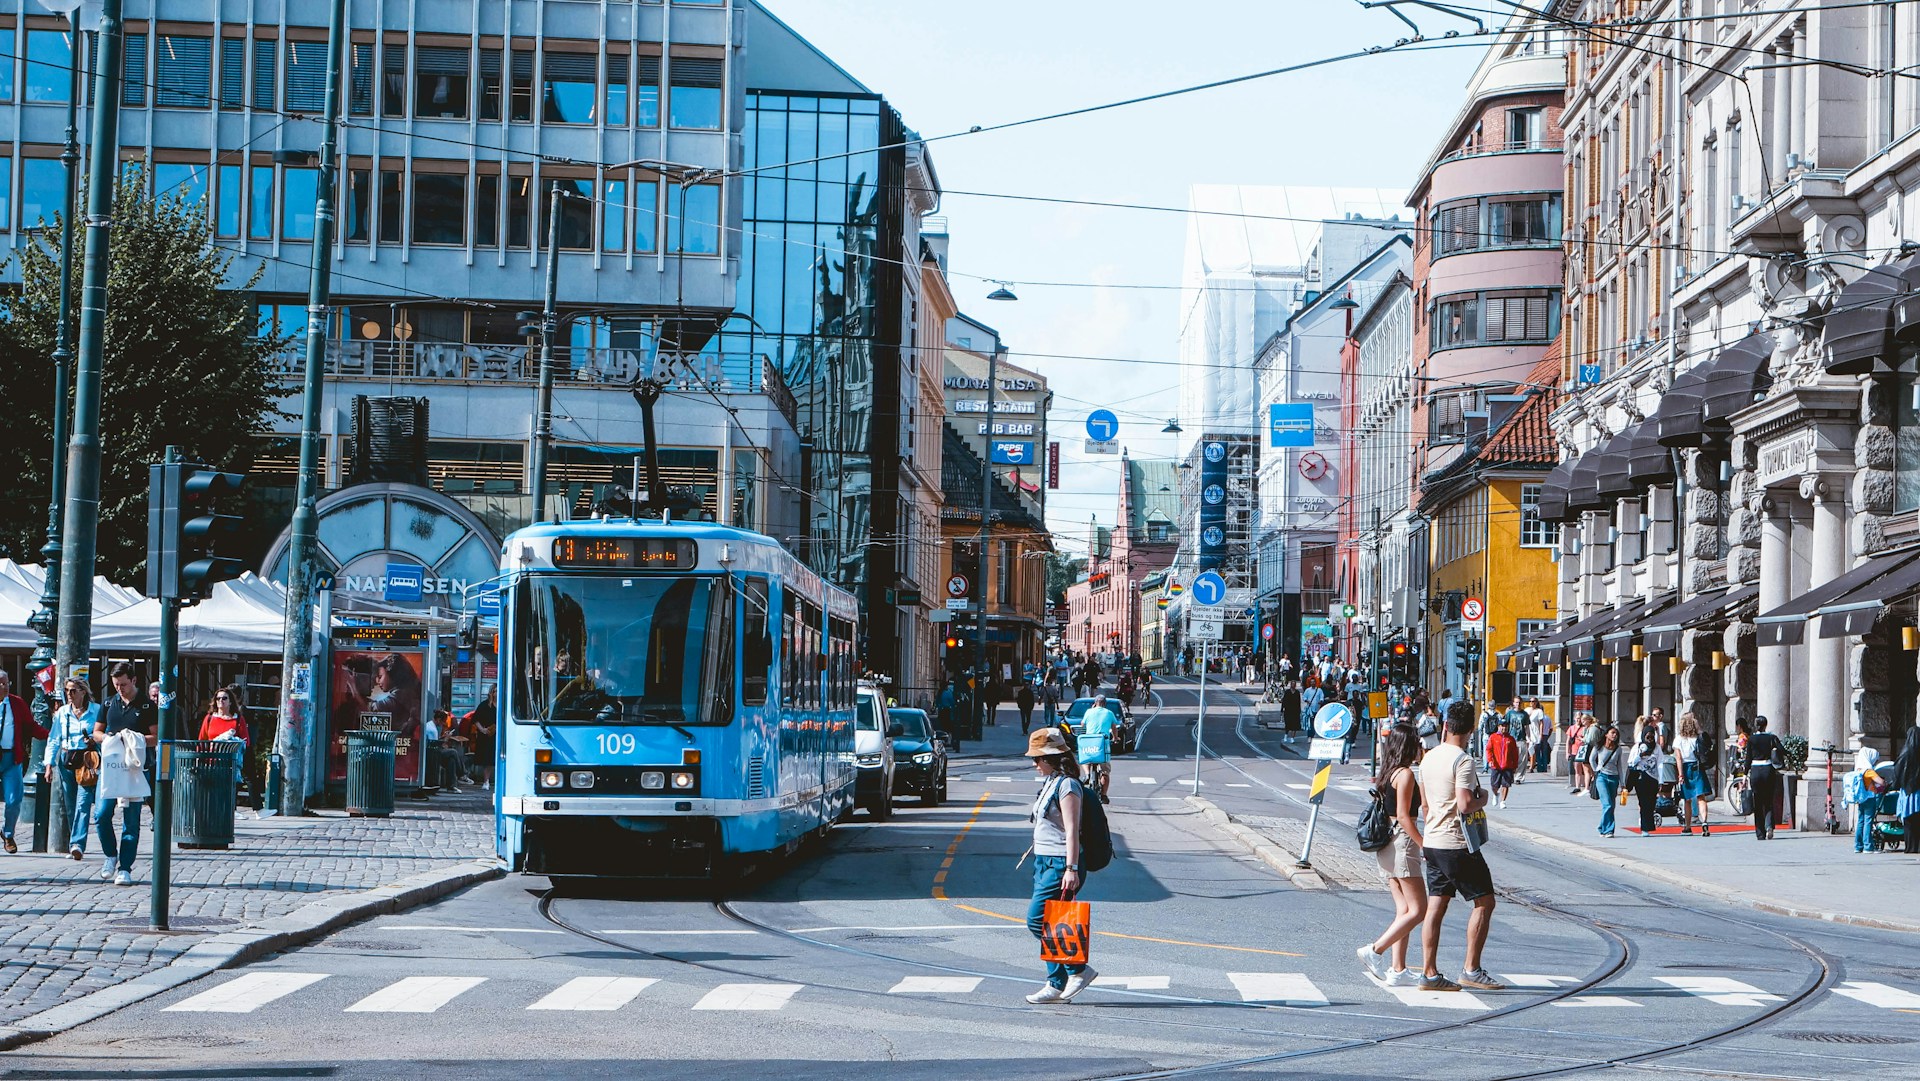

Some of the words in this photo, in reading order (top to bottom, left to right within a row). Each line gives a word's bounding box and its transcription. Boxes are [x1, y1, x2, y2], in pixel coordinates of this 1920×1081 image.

[944, 377, 989, 389] MONA
[1001, 379, 1036, 390] LISA
[1009, 425, 1032, 434] BAR
[997, 443, 1024, 451] PEPSI
[1302, 503, 1319, 511] City
[1411, 646, 1418, 654] S
[596, 733, 635, 754] 109
